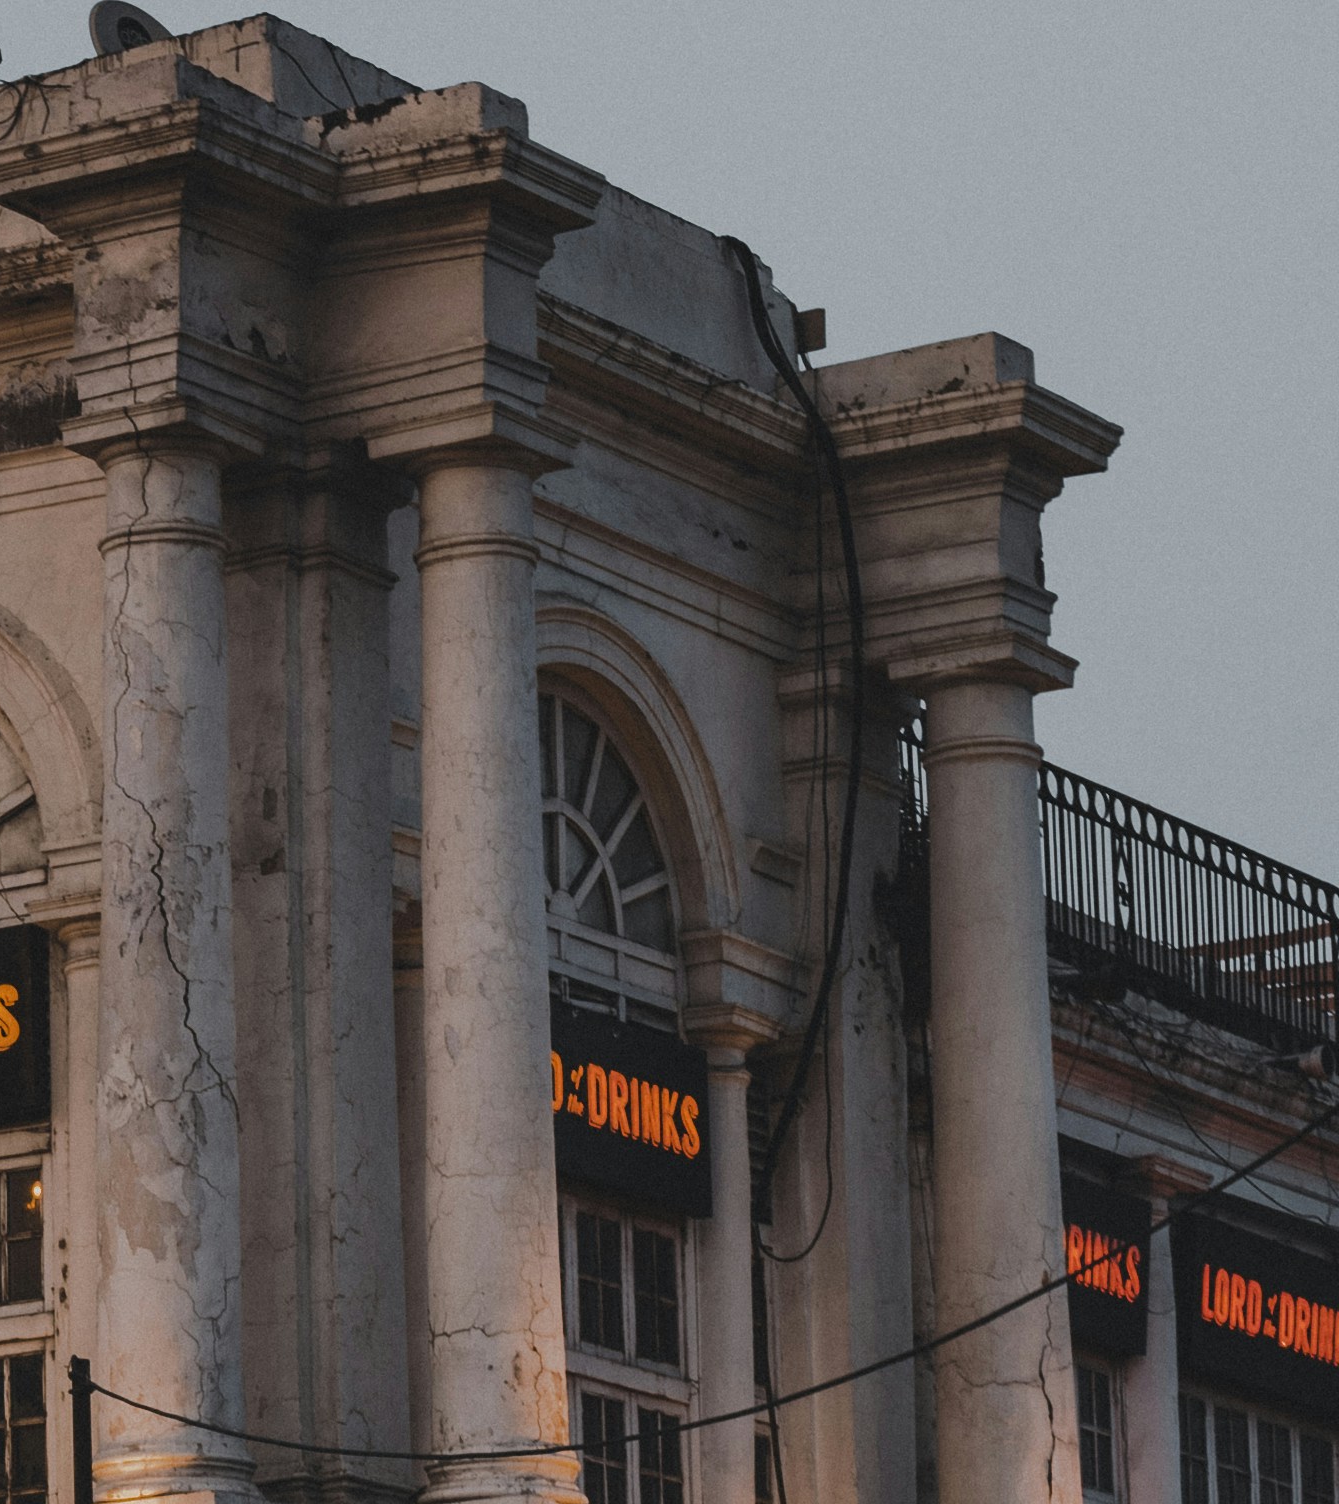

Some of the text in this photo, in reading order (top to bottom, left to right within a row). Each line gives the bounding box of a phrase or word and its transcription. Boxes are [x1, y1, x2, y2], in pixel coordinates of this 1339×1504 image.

[586, 1062, 701, 1160] DRINKS
[1062, 1224, 1141, 1304] RINKS
[1201, 1263, 1264, 1338] LORD
[1278, 1291, 1339, 1368] DRIN
